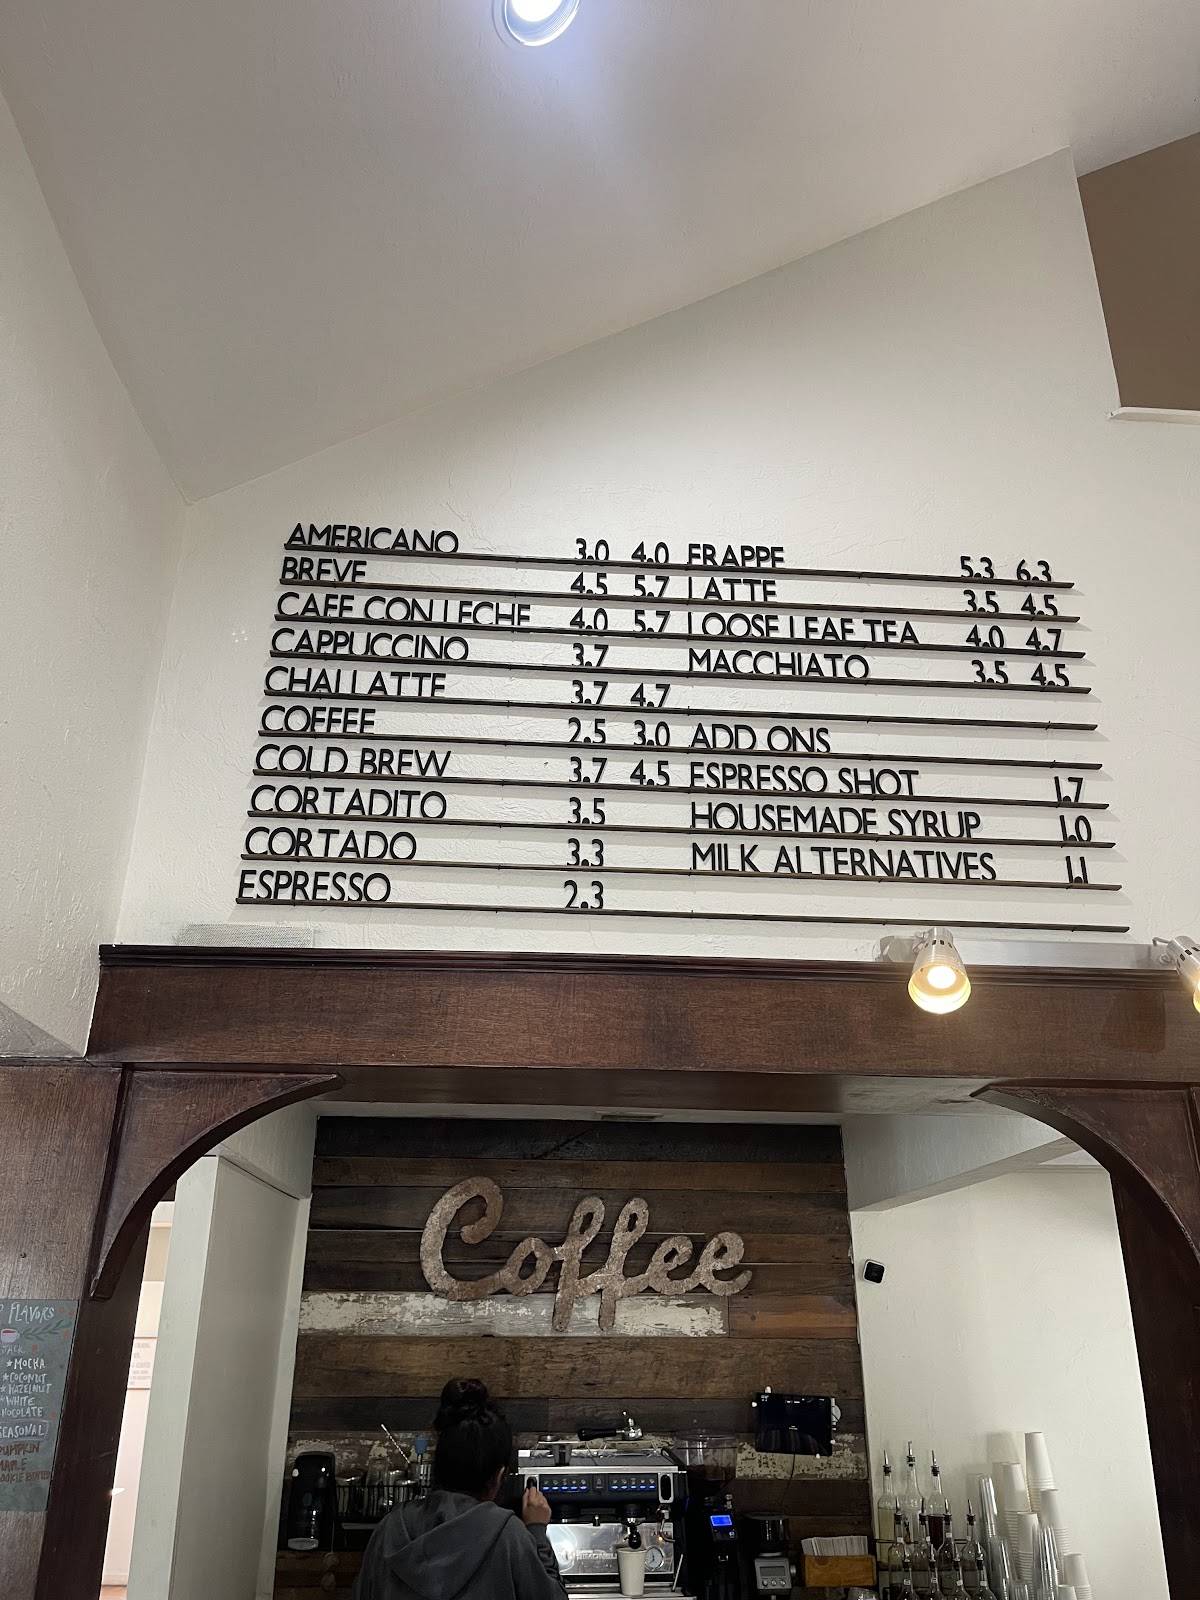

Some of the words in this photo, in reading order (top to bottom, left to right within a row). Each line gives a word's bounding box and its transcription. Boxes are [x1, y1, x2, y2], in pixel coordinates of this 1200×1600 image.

[287, 523, 459, 553] AMERICANO
[576, 538, 609, 560] 3.0
[631, 541, 669, 563] 4.0
[688, 543, 784, 567] FRAPPE
[960, 556, 994, 578] 5.3
[1016, 559, 1051, 581] 6.3
[282, 557, 367, 582] BREVE
[570, 572, 607, 594] 4.5
[634, 575, 670, 597] 5.7
[277, 592, 354, 617] CAFE
[364, 596, 433, 621] CON
[570, 607, 608, 630] 4.0
[634, 610, 670, 632] 5.7
[963, 590, 999, 612] 3.5
[1021, 593, 1058, 615] 4.5
[271, 627, 469, 660] CAPPUCCINO
[572, 643, 609, 666] 3.7
[863, 619, 919, 643] TEA
[966, 624, 1004, 648] 4.0
[1026, 627, 1061, 650] 4.7
[689, 648, 869, 678] MACCHIATO
[972, 660, 1008, 683] 3.5
[1031, 662, 1069, 686] 4.5
[265, 666, 341, 693] CHAI
[571, 680, 608, 704] 3.7
[630, 683, 670, 707] 4.7
[261, 705, 376, 734] COFFEE
[568, 717, 606, 743] 2.5
[634, 720, 670, 746] 3.0
[690, 723, 756, 750] ADD
[766, 726, 831, 753] ONS
[255, 744, 348, 773] COLD
[359, 749, 451, 776] BREW
[569, 757, 607, 783] 3.7
[630, 759, 670, 785] 4.5
[690, 762, 828, 793] ESPRESSO
[838, 767, 919, 796] SHOT
[251, 784, 447, 818] CORTADITO
[568, 797, 605, 824] 3.5
[691, 802, 877, 835] HOUSEMADE
[888, 809, 981, 839] SYRUP
[245, 826, 417, 860] CORTADO
[567, 838, 603, 866] 3.3
[692, 842, 760, 872] MILK
[774, 845, 997, 880] ALTERNATIVES
[238, 869, 391, 902] ESPRESSO
[564, 880, 603, 908] 2.3
[420, 1176, 753, 1332] Coffee
[14, 1357, 46, 1370] MOCHA
[6, 1396, 35, 1406] WHITE
[8, 1384, 52, 1395] HAZELNUT
[0, 1407, 44, 1417] HOCOLATE
